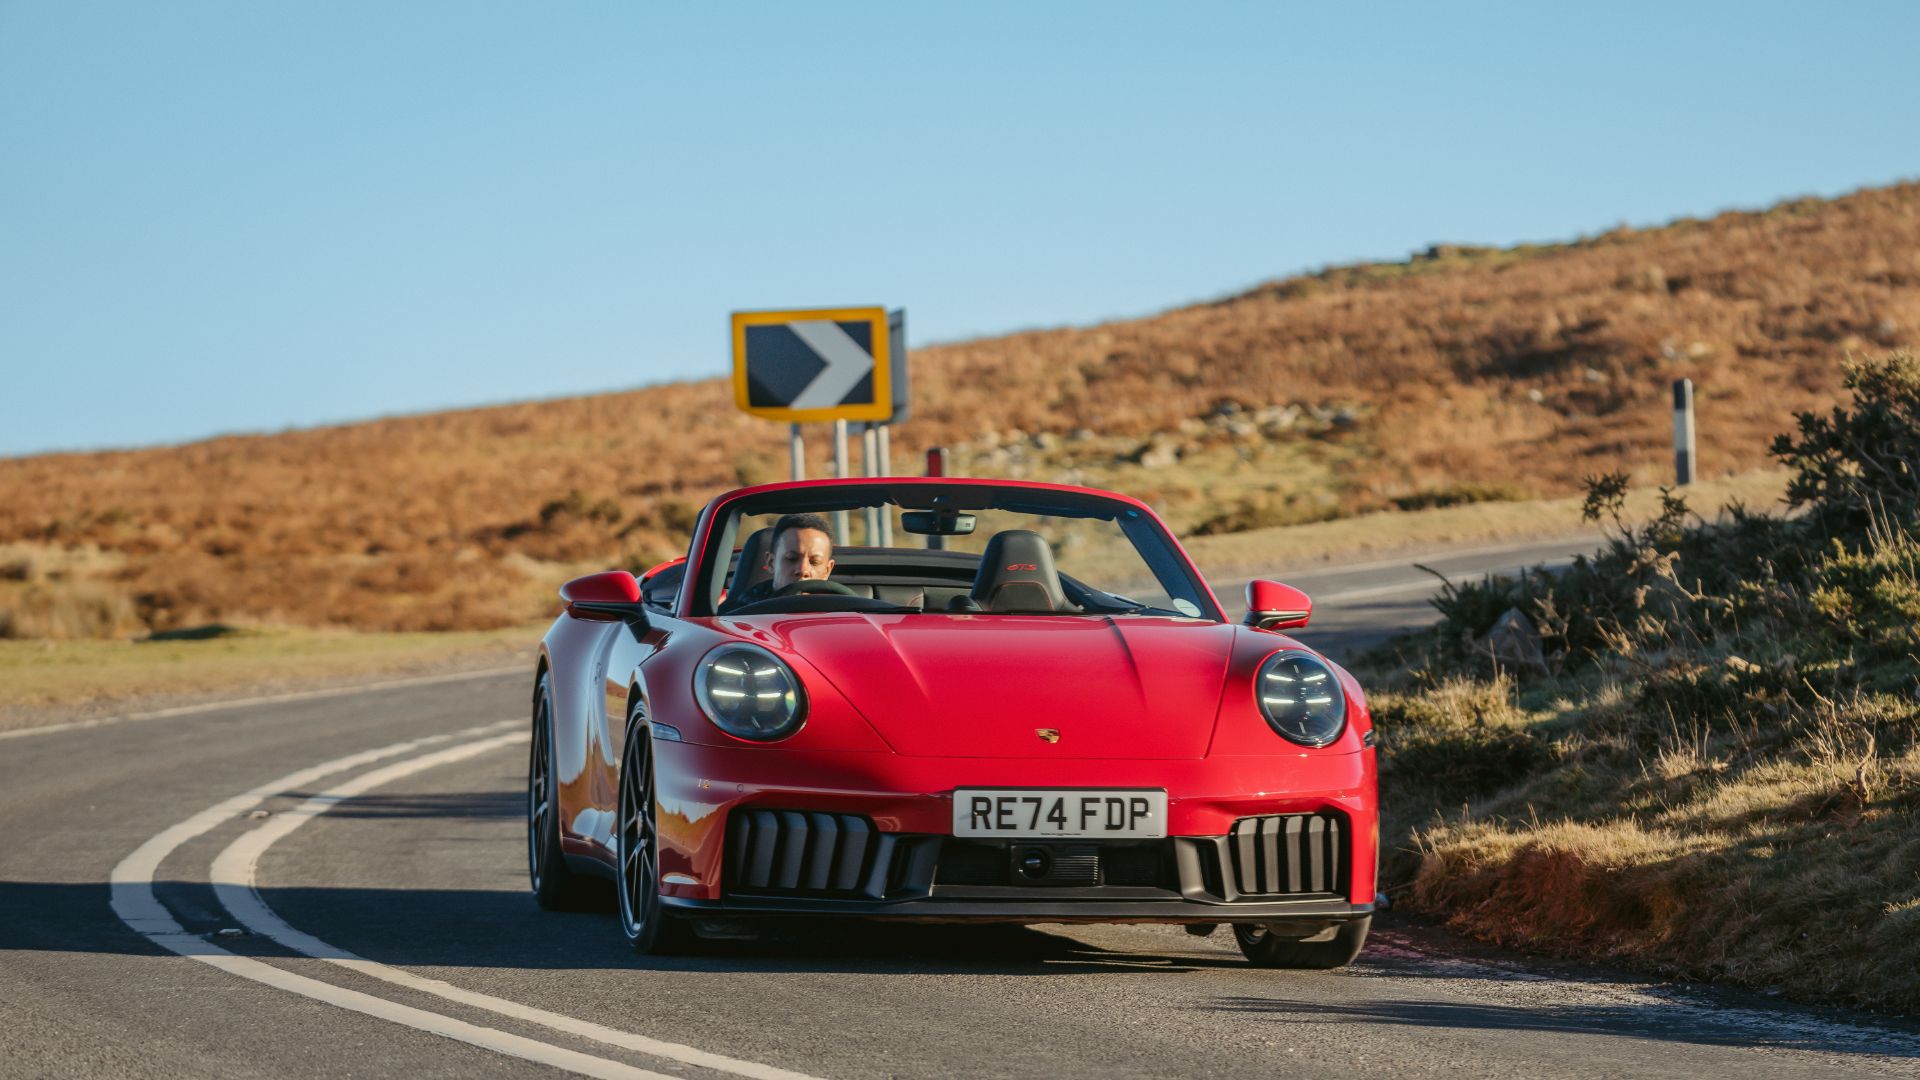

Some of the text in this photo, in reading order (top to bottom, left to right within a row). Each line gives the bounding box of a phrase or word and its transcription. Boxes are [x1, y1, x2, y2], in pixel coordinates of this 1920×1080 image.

[1007, 563, 1037, 572] GTS
[970, 796, 1150, 831] RE74 FDP
